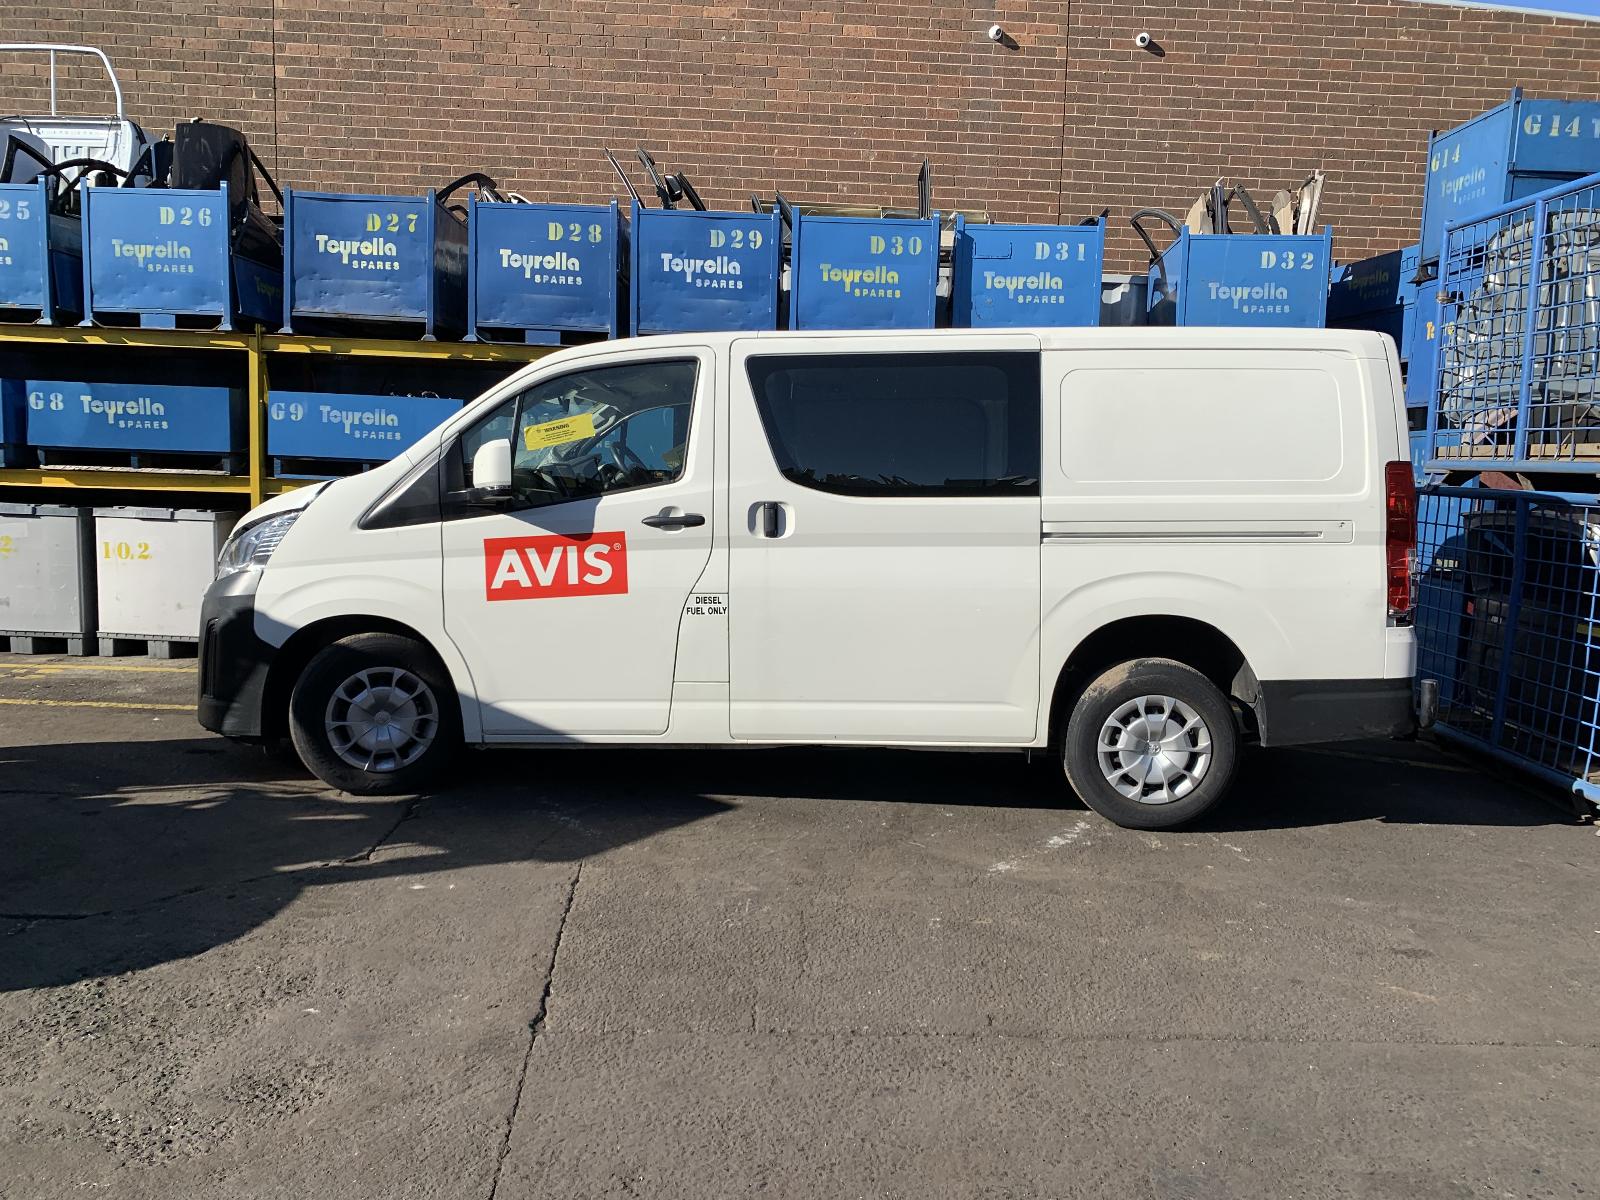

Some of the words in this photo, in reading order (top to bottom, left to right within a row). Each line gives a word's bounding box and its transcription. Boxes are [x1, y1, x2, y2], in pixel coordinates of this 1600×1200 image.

[112, 238, 191, 268] Toyrolla
[316, 234, 397, 264] Toyrolla
[147, 264, 194, 273] SPARES
[352, 260, 400, 270] SPARES
[500, 249, 580, 278] Toyrolla
[661, 253, 741, 282] Toyrolla
[534, 275, 583, 285] SPARES
[820, 263, 899, 292] Toyrolla
[695, 279, 743, 289] SPARES
[984, 271, 1063, 299] Toyrolla
[854, 288, 901, 298] SPARES
[1208, 282, 1288, 309] Toyrolla
[1017, 295, 1065, 304] SPARES
[1242, 304, 1290, 314] SPARES
[80, 395, 165, 424] Toyrolla
[119, 420, 168, 429] SPARES
[320, 405, 398, 434] Toyrolla
[354, 430, 401, 441] SPARES
[695, 596, 722, 604] DIESEL
[686, 606, 705, 615] FUEL
[707, 606, 728, 615] ONLY
